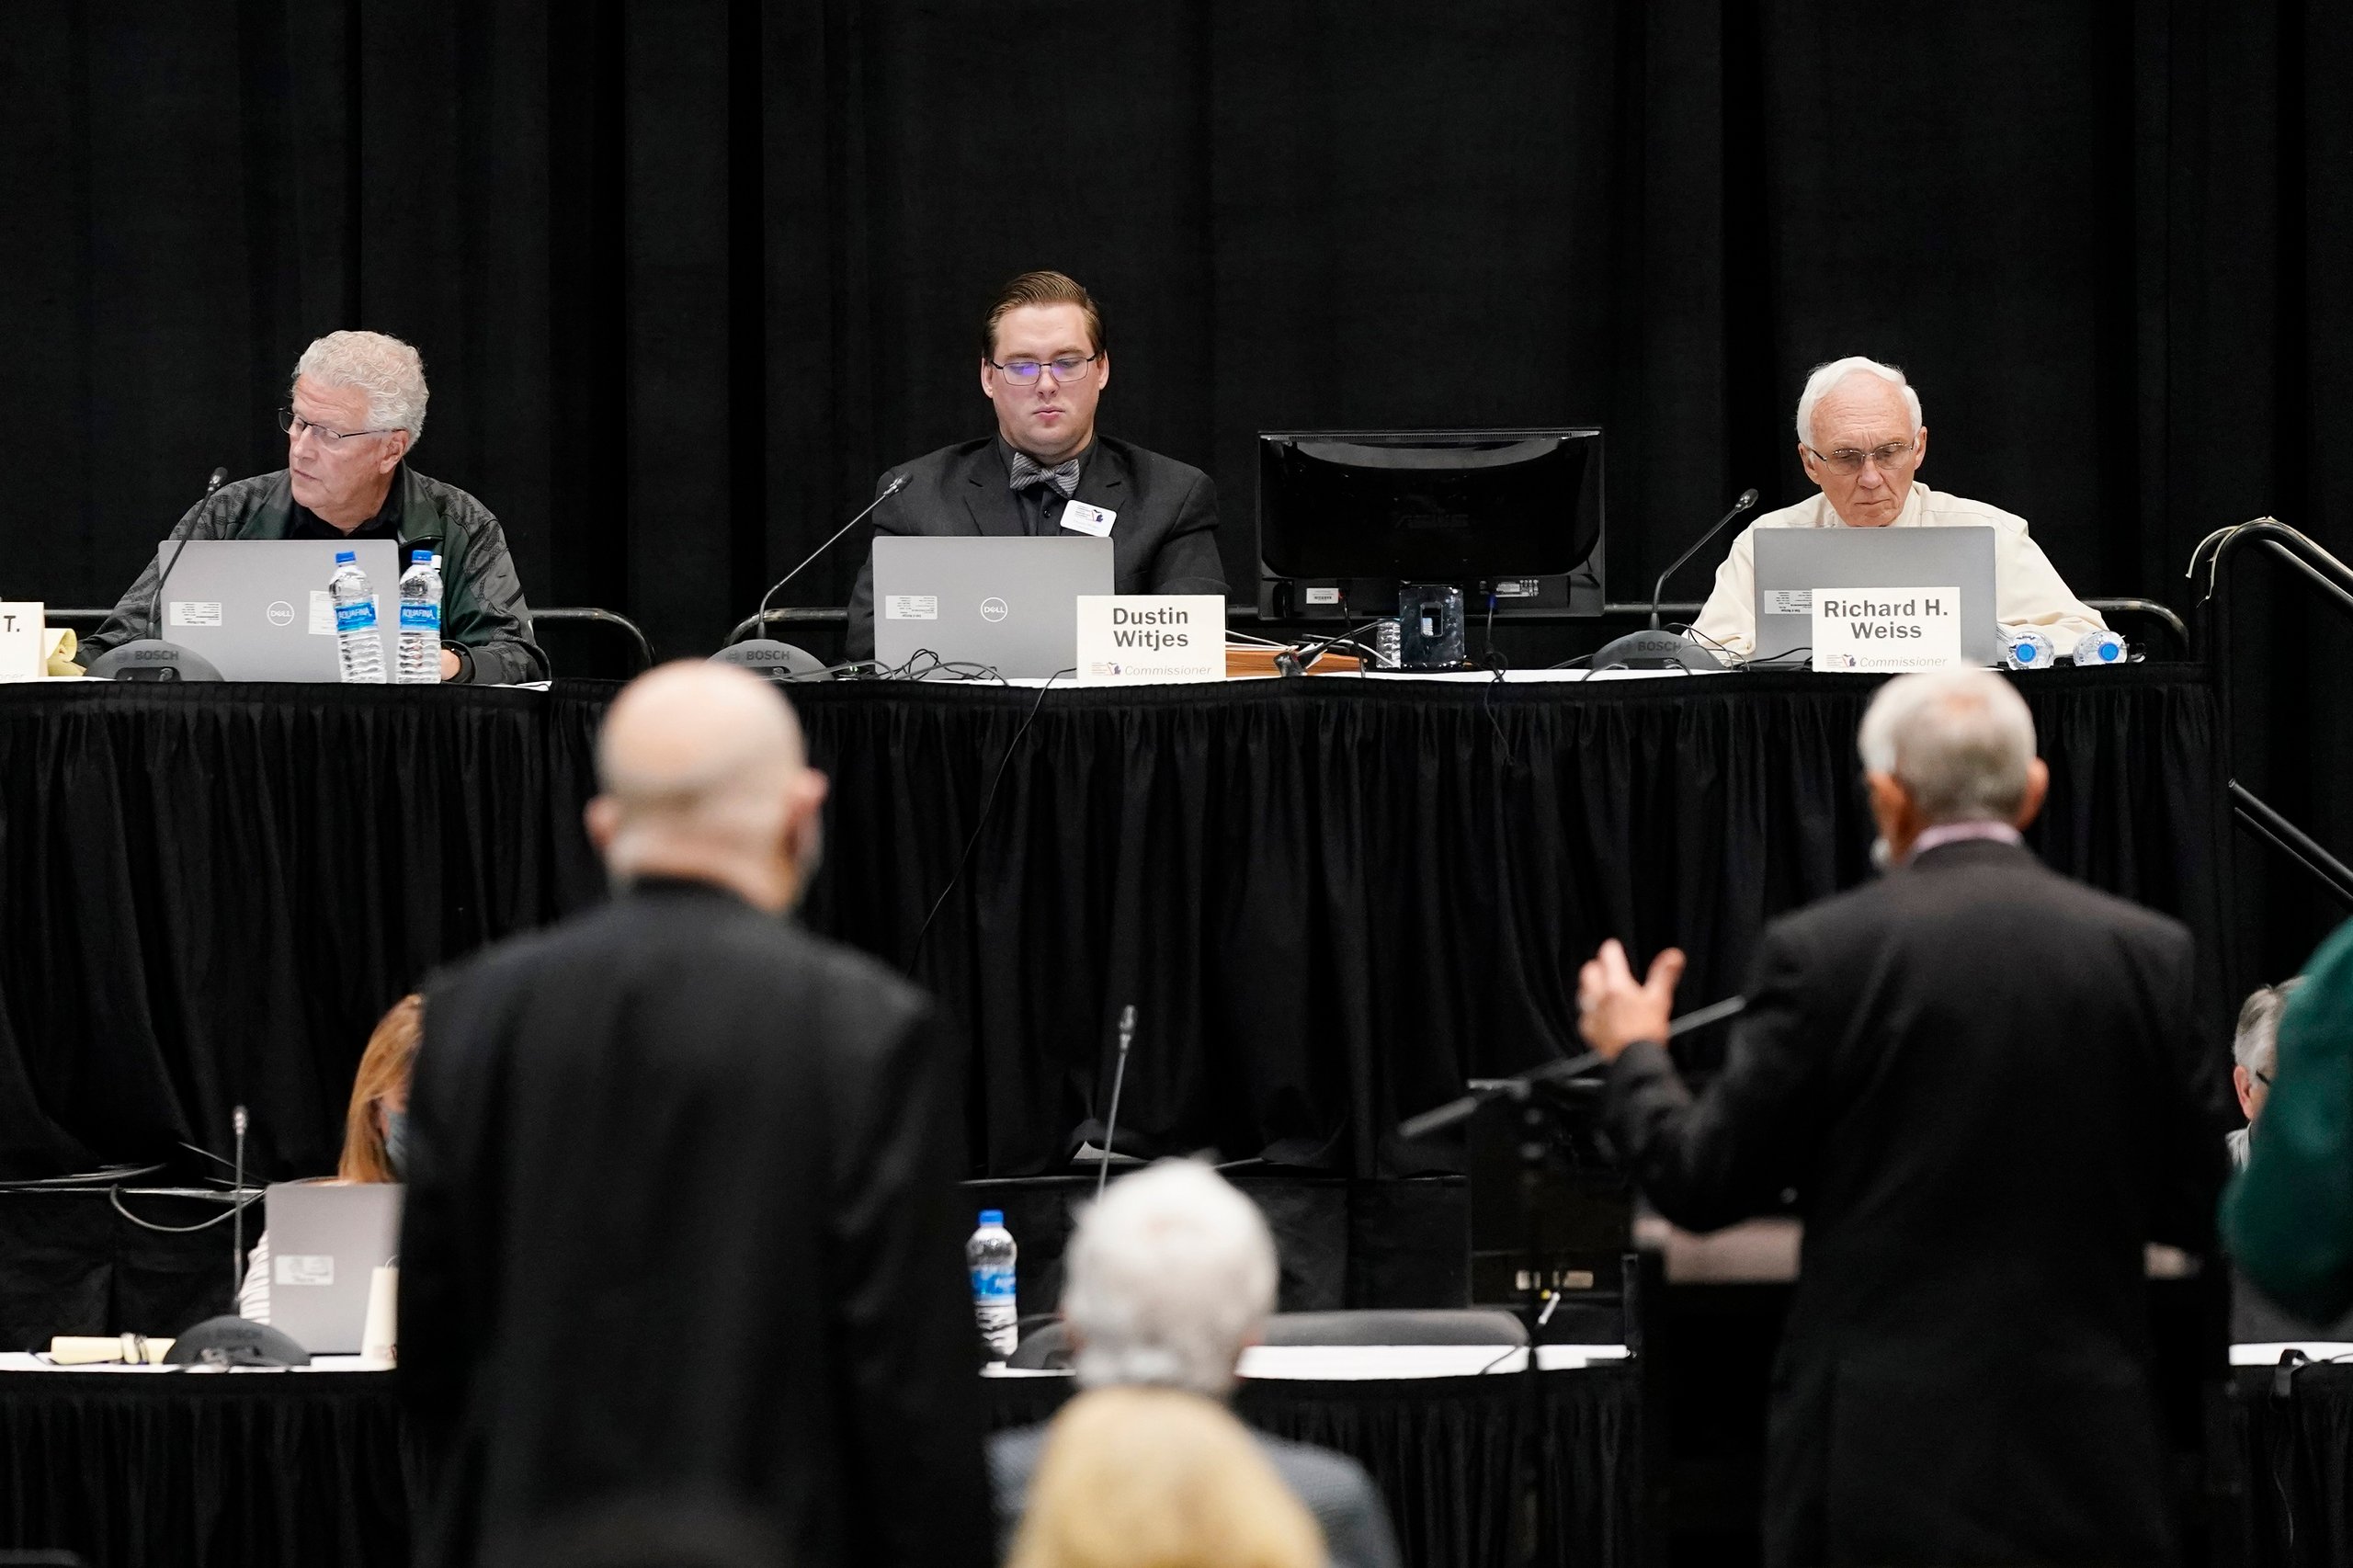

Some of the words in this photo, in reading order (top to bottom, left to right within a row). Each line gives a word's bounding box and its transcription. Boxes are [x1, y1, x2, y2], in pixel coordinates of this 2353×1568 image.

[983, 605, 1005, 614] DELL
[1824, 599, 1915, 618] Richard
[1926, 599, 1949, 616] H.
[1113, 607, 1188, 625] Dustin
[4, 615, 20, 632] T.
[1851, 621, 1922, 639] Weiss
[1113, 630, 1189, 652] Witjes
[1638, 641, 1682, 652] BOSCH
[134, 650, 179, 661] BOSCH
[745, 650, 790, 661] BOSCH
[1859, 656, 1948, 668] Commissioner
[1124, 665, 1212, 676] Commissioner
